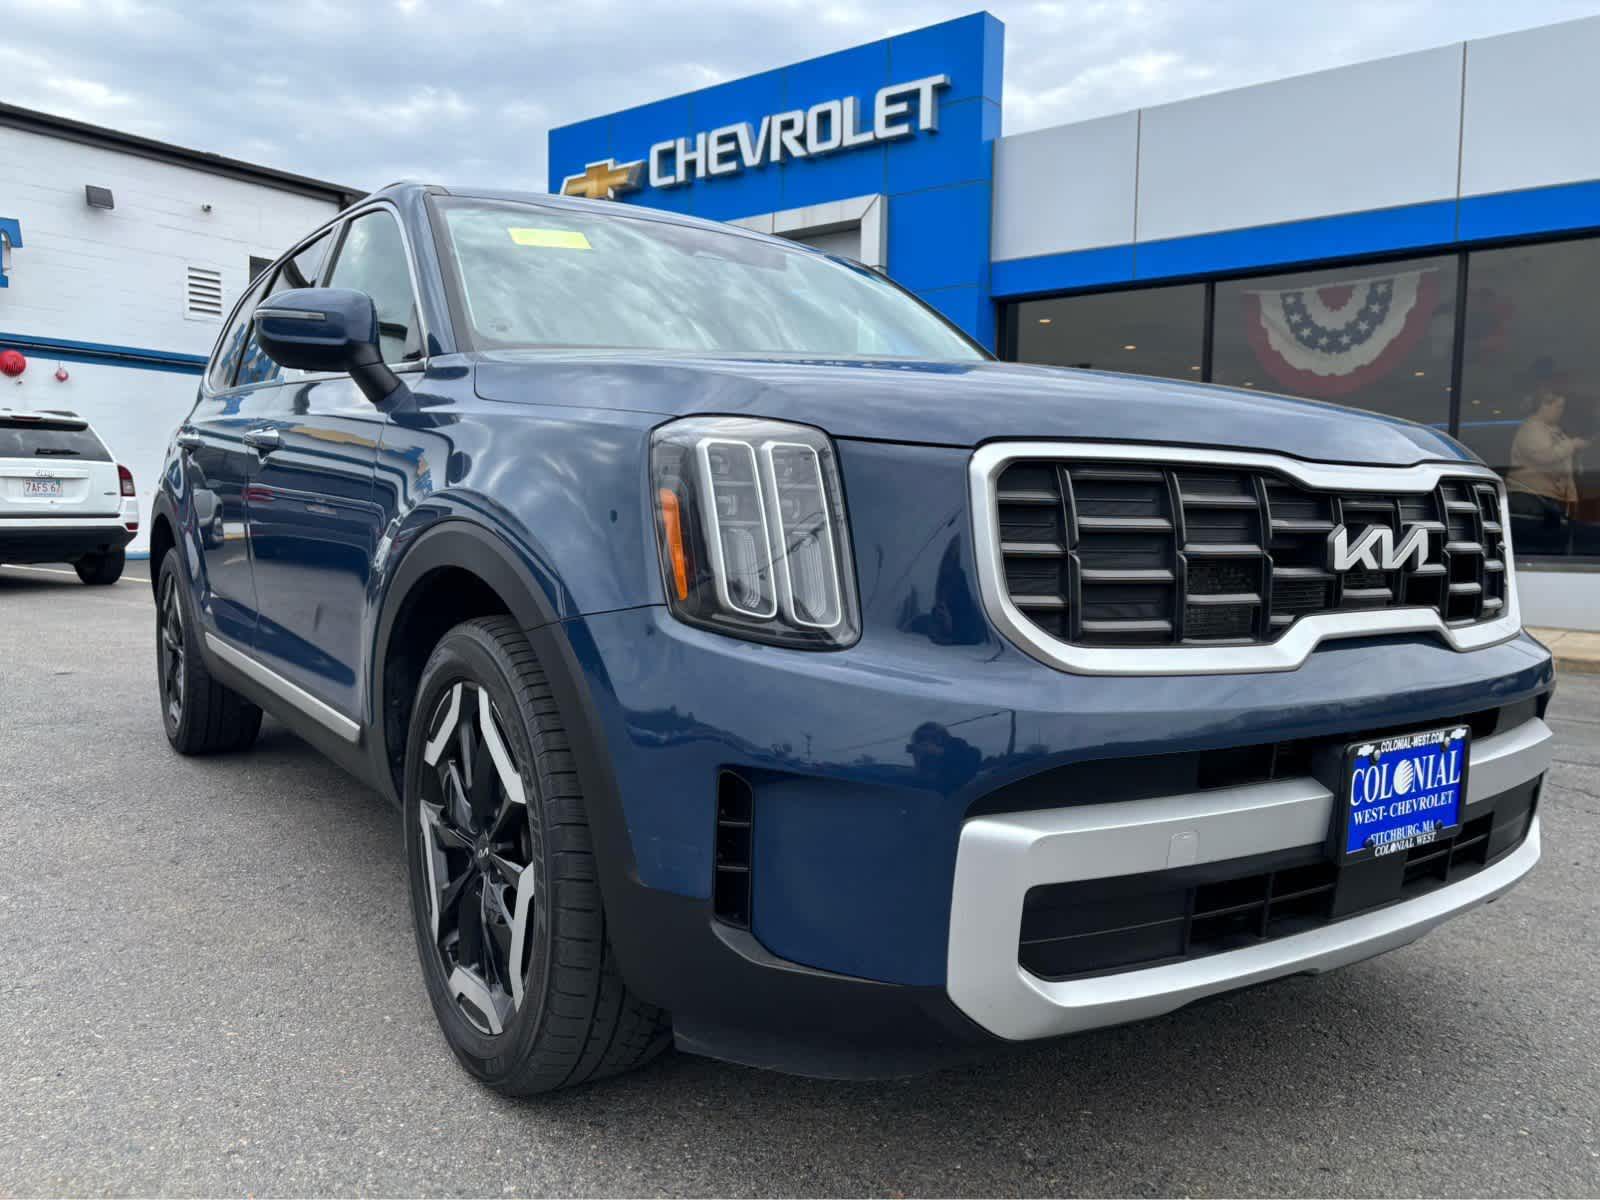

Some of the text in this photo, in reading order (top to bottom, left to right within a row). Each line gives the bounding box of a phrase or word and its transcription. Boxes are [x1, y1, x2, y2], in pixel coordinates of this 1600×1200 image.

[649, 74, 951, 188] CHEVROLET
[1330, 525, 1429, 570] KIA
[1381, 732, 1445, 752] COLONIAL-WEST.COM
[1350, 750, 1461, 806] COLONIAL
[1375, 832, 1437, 857] COLONIAL WEST
